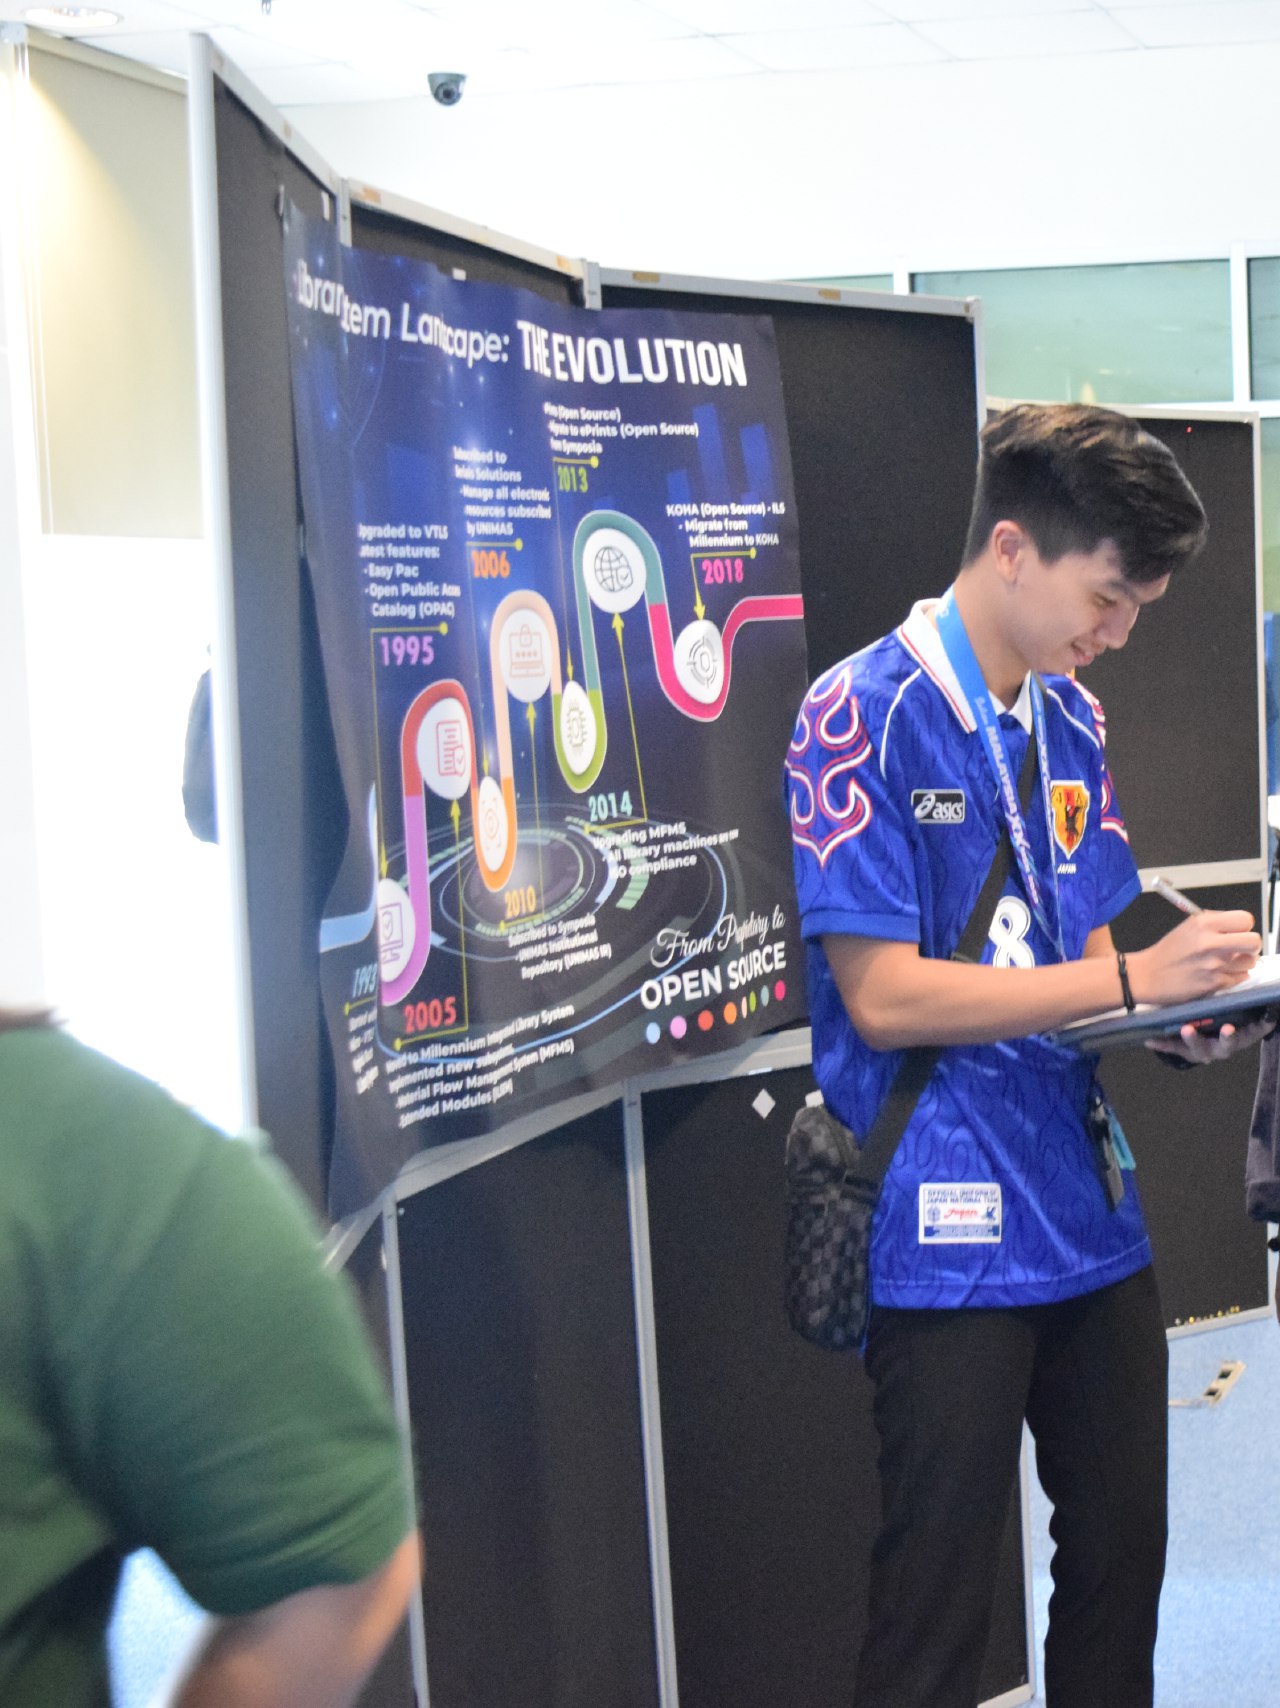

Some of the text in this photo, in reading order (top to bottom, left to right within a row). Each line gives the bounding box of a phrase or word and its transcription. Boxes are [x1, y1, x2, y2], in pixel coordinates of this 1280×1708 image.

[516, 320, 551, 378] THE
[552, 332, 748, 387] EVOLUTION
[580, 406, 622, 423] Source)
[620, 422, 658, 439] (Open
[660, 421, 699, 438] Source)
[495, 450, 507, 464] to
[475, 466, 521, 482] Solutions
[558, 466, 588, 493] 2013
[496, 485, 508, 500] all
[666, 503, 699, 517] KOHA
[701, 502, 729, 518] (Open
[730, 501, 765, 517] Source)
[408, 525, 422, 539] to
[424, 525, 448, 540] VTLS
[476, 521, 513, 536] UNIMAS
[685, 518, 723, 533] Migrate
[724, 518, 748, 531] from
[689, 533, 779, 548] Millennium to KOHA
[396, 563, 419, 578] Pac
[471, 550, 510, 578] 2006
[702, 558, 744, 584] 2018
[401, 582, 439, 597] Public
[372, 602, 416, 619] Catalog
[380, 635, 434, 666] 1995
[986, 726, 1017, 814] MALAYSIA
[589, 790, 633, 822] 2014
[932, 802, 963, 820] asics
[649, 822, 686, 839] MFMS
[623, 843, 660, 860] library
[664, 832, 718, 853] machines
[629, 854, 698, 875] compliance
[504, 885, 537, 919] 2010
[548, 923, 558, 936] to
[650, 928, 714, 968] From
[772, 904, 785, 930] to
[988, 895, 1035, 968] 8
[640, 941, 787, 1010] OPEN SOURCE
[404, 996, 457, 1034] 2005
[420, 1036, 486, 1061] Millennium
[541, 1004, 575, 1026] System
[433, 1078, 464, 1097] Flow
[539, 1037, 575, 1063] (MFMS)
[446, 1057, 475, 1075] new
[442, 1093, 491, 1114] Modules
